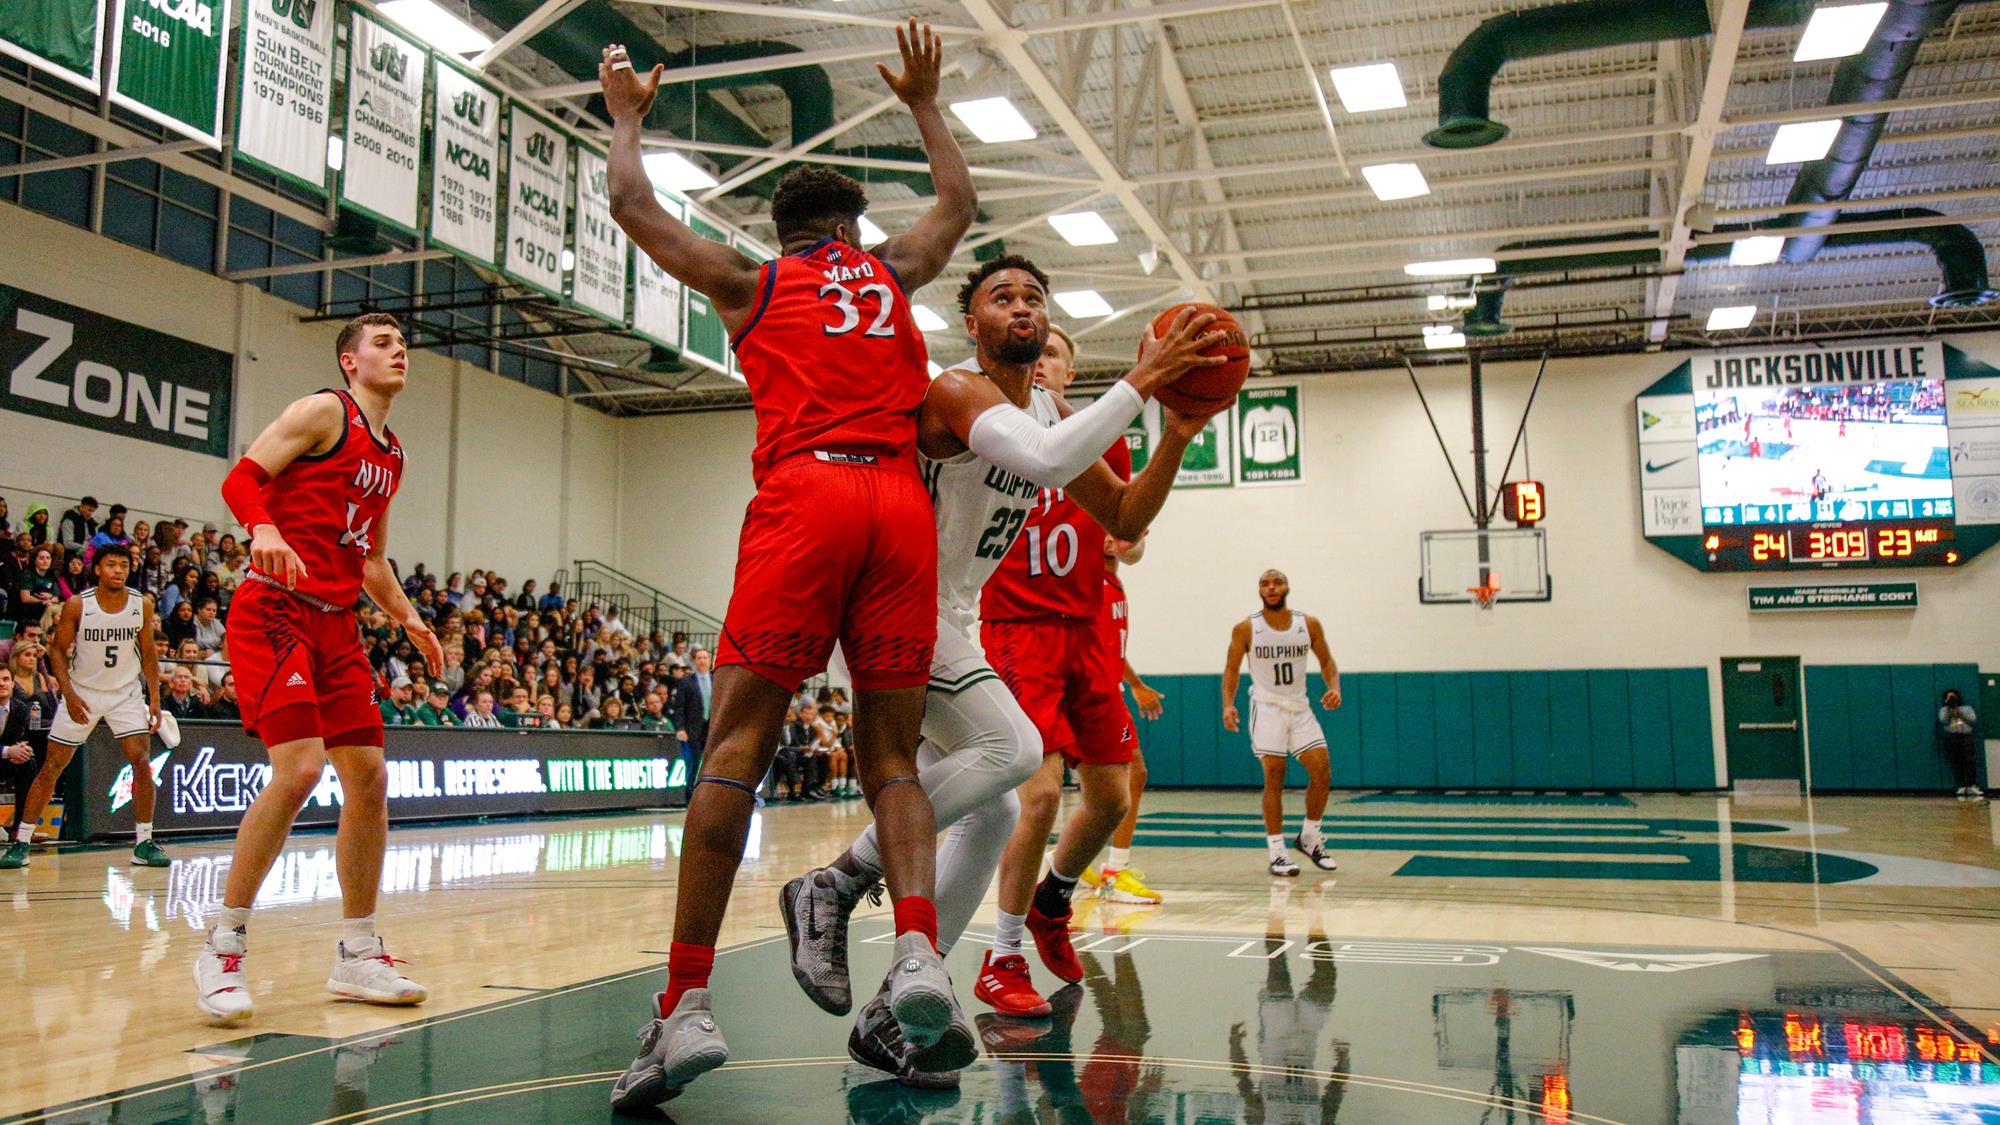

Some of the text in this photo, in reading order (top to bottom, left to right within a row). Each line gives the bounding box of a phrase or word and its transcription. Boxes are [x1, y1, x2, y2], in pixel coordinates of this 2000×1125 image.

[132, 15, 171, 48] 2016
[139, 0, 212, 37] CAA
[254, 10, 328, 57] MEN'S BASKETBALL
[253, 62, 324, 107] CHAMPIONS
[254, 48, 325, 91] TOURNAMENT
[253, 81, 323, 125] 1979 1986
[378, 78, 418, 108] BASKETBALL
[354, 108, 416, 149] CHAMPIONS
[353, 132, 415, 171] 2009 2010
[445, 139, 490, 182] NCAA
[440, 190, 493, 223] 1973 1979
[441, 175, 492, 208] 1970 1971
[519, 181, 560, 222] NCAA
[440, 205, 463, 226] 1986
[512, 205, 562, 238] FINAL FOUR
[585, 213, 622, 248] NIT
[514, 236, 557, 274] 1970
[823, 261, 875, 284] MAYO
[818, 282, 896, 338] 32
[1706, 347, 1927, 388] JACKSONVILLE
[1248, 389, 1287, 399] MORTON
[1260, 429, 1279, 442] 12
[1518, 492, 1541, 520] 13
[975, 506, 1027, 560] 23
[1752, 533, 1786, 561] 24
[1809, 531, 1866, 559] 3:09
[1878, 529, 1912, 557] 23
[1025, 523, 1079, 579] 10
[1753, 591, 1914, 605] TIM AND STEPHANIE COST
[84, 626, 140, 642] DOLPHINS
[104, 645, 119, 669] 5
[1255, 644, 1309, 659] DOLPHINS
[1274, 662, 1294, 686] 10
[547, 759, 585, 793] WITH
[586, 759, 613, 792] THE
